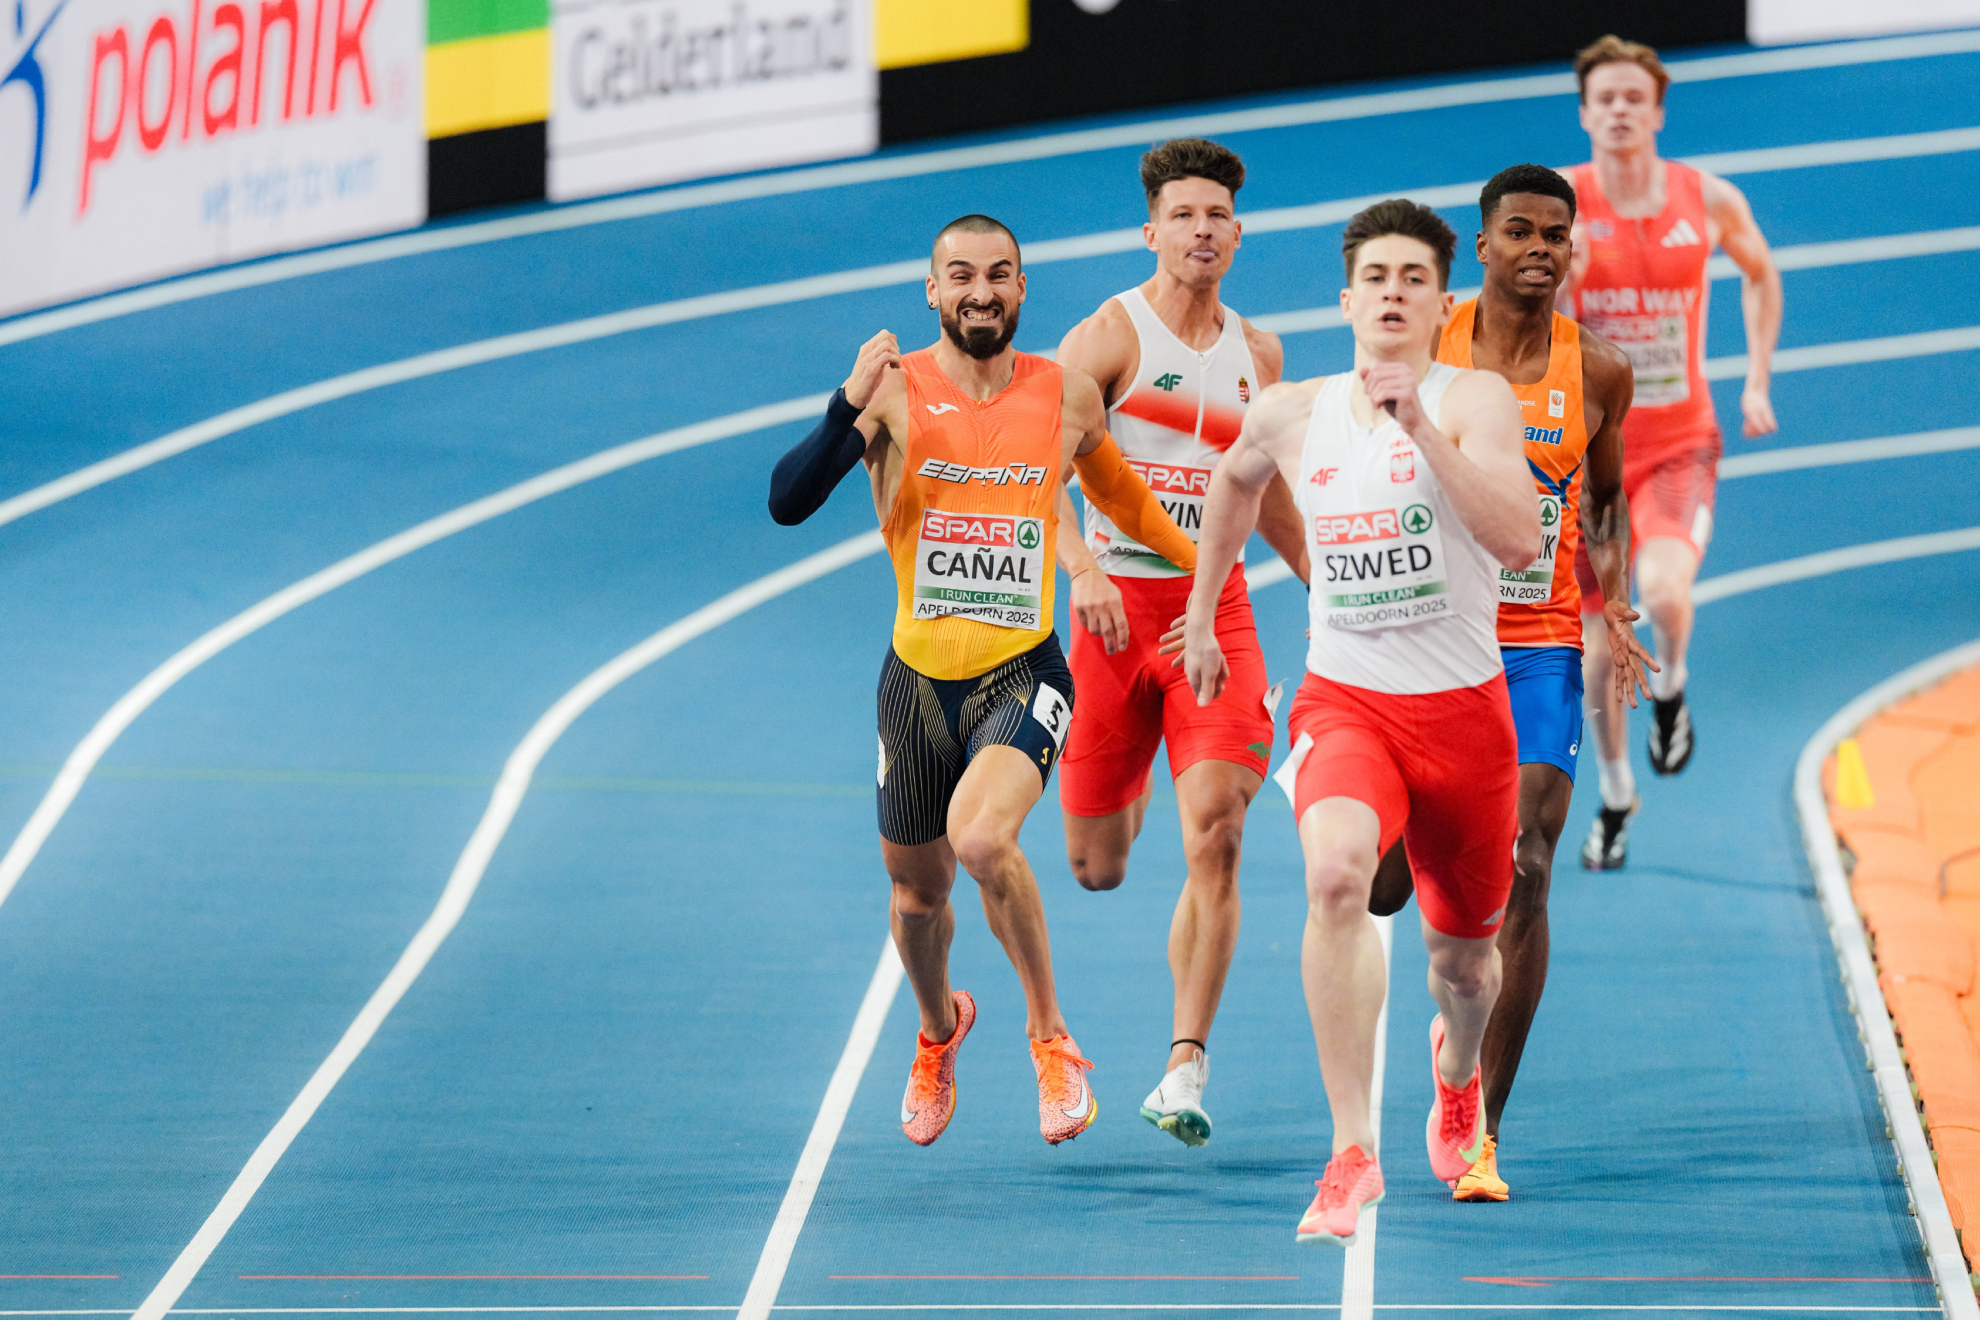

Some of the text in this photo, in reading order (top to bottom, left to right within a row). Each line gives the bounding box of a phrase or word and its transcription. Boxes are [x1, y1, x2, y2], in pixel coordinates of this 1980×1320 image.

[77, 0, 378, 216] polanik
[1523, 421, 1564, 445] and
[917, 458, 1047, 486] ESPAÑA
[925, 516, 1012, 543] SPAR
[1317, 512, 1398, 542] SPAR
[927, 547, 1031, 583] CAÑAL
[1326, 544, 1432, 582] SZWED
[940, 589, 945, 598] I
[946, 589, 971, 602] RUN
[1518, 587, 1546, 600] 2025
[1006, 610, 1036, 625] 2025
[1327, 597, 1448, 627] APELDOORN 2025
[1047, 699, 1064, 733] 5
